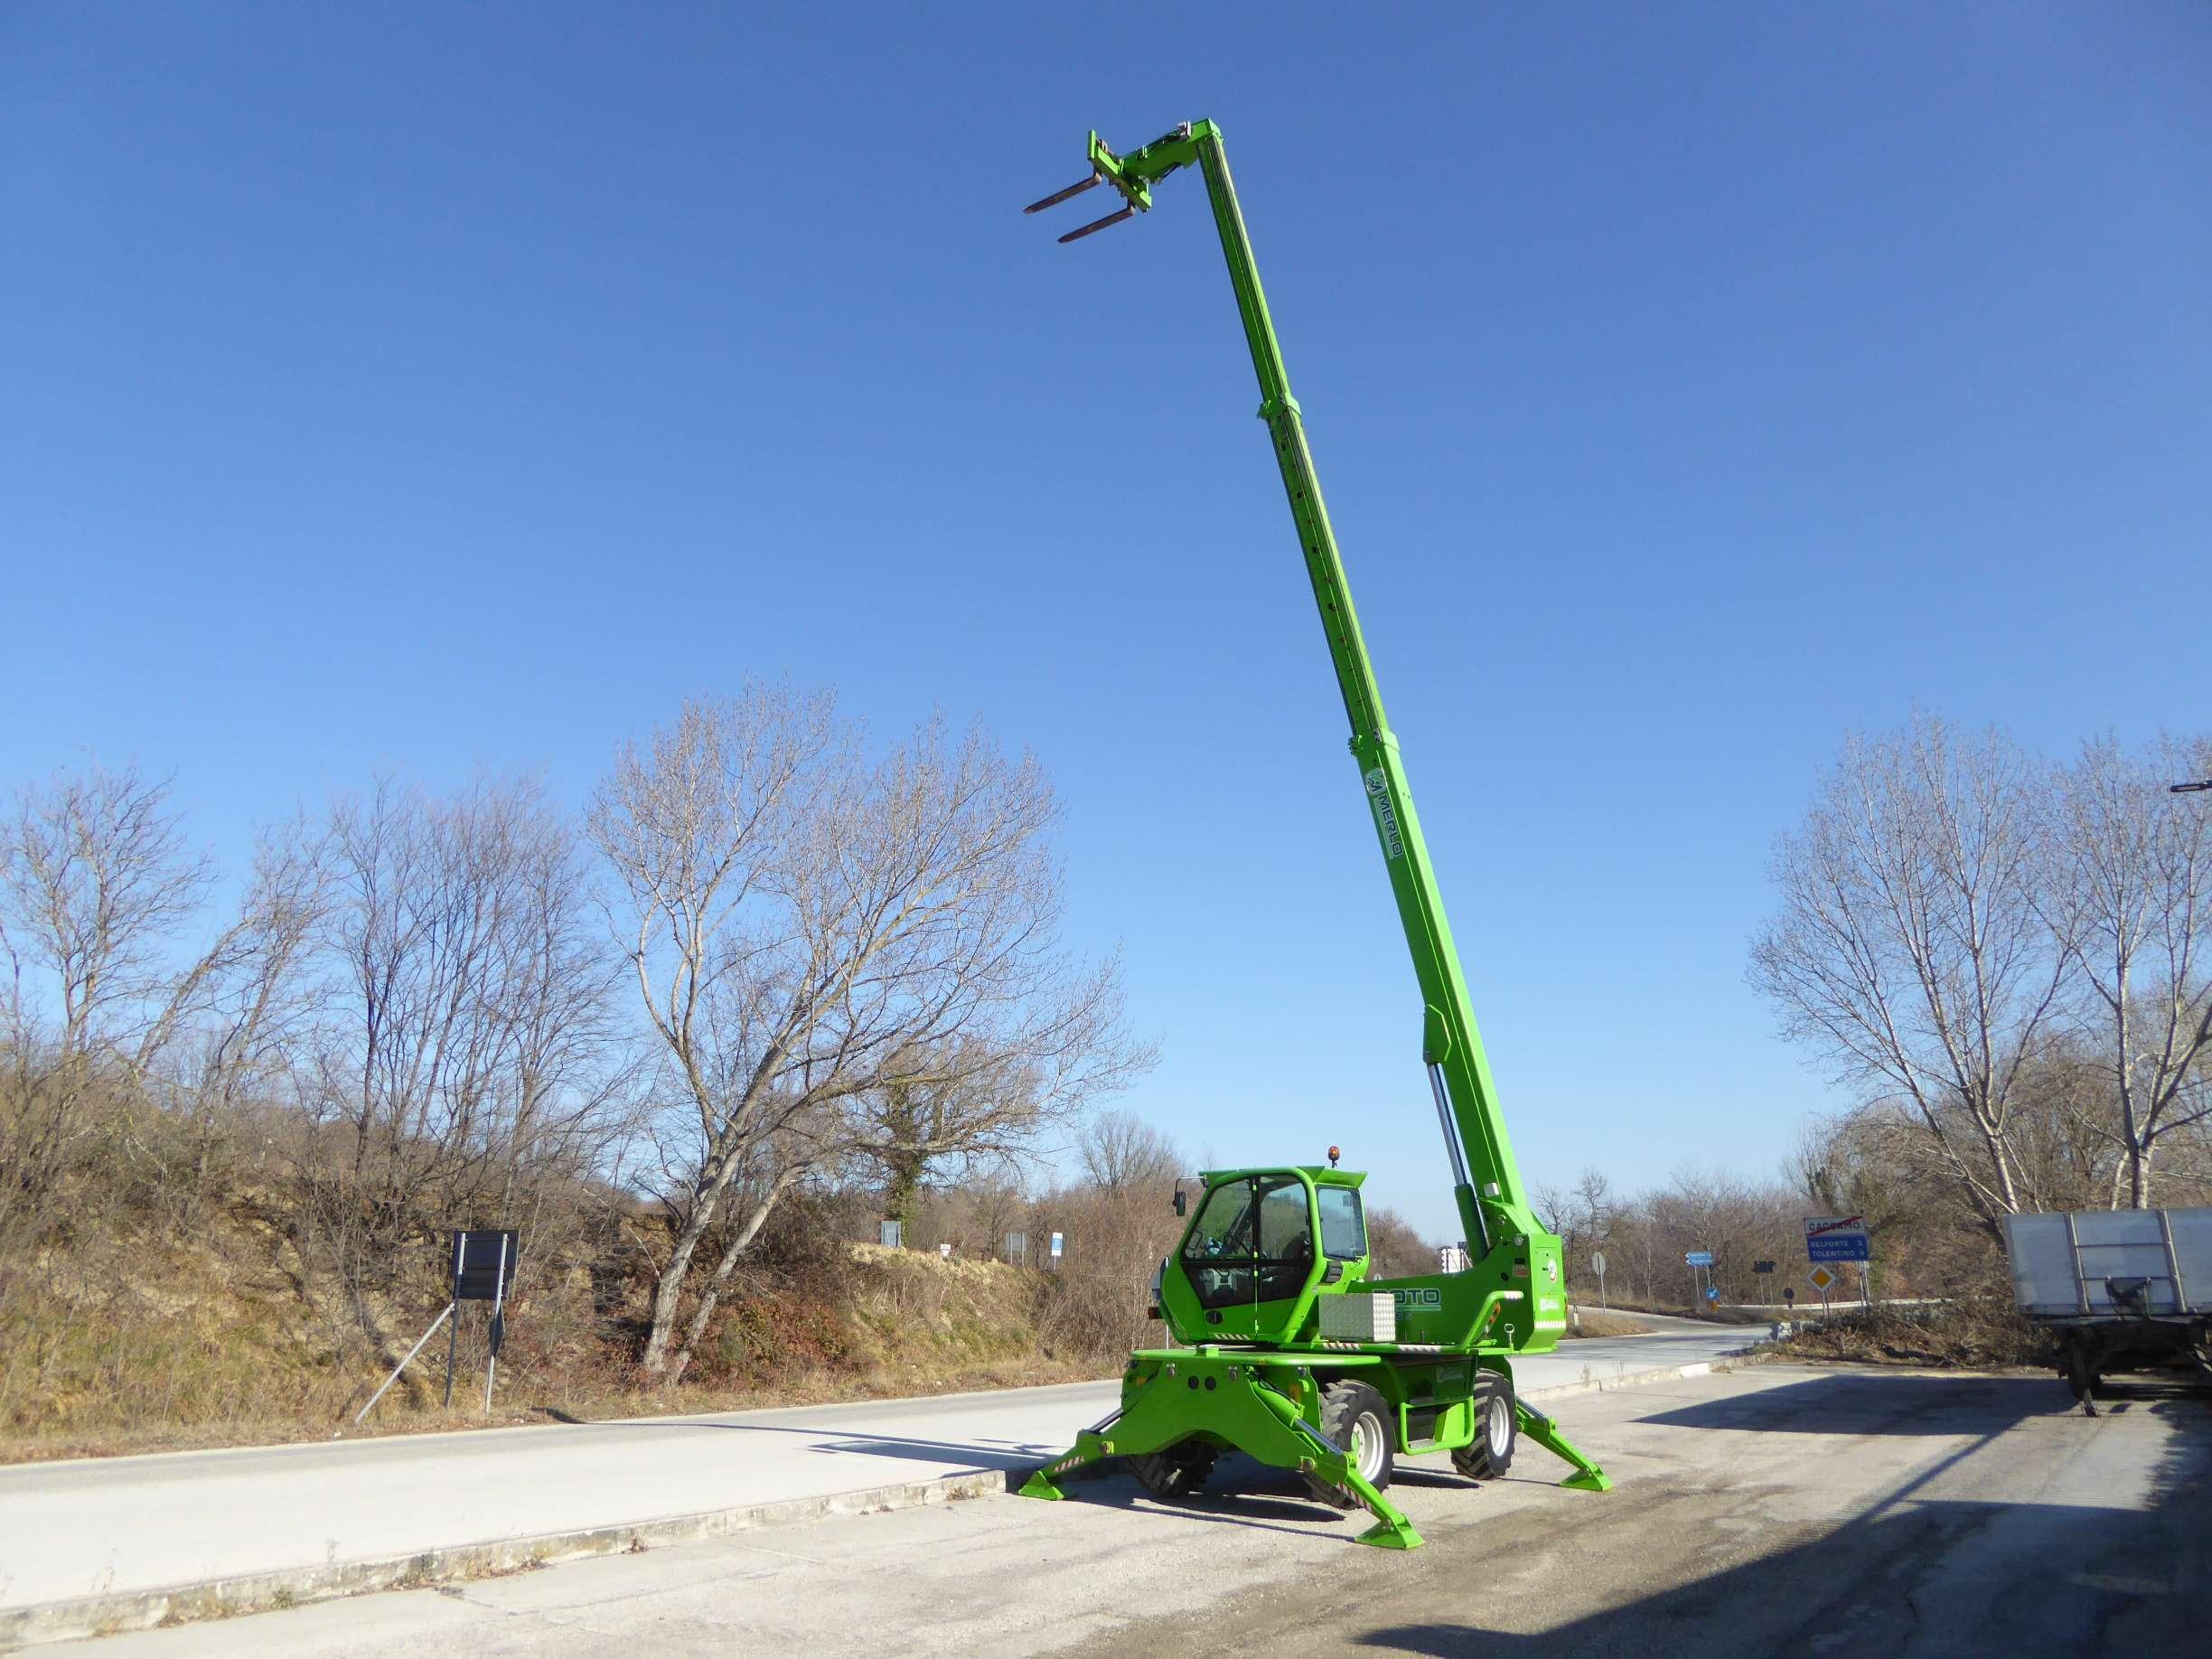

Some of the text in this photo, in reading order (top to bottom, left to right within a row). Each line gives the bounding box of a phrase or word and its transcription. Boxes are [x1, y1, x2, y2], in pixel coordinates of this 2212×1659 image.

[1379, 793, 1403, 857] MERLO
[1811, 1250, 1855, 1258] TOLENTINO
[1373, 1289, 1440, 1304] OTO
